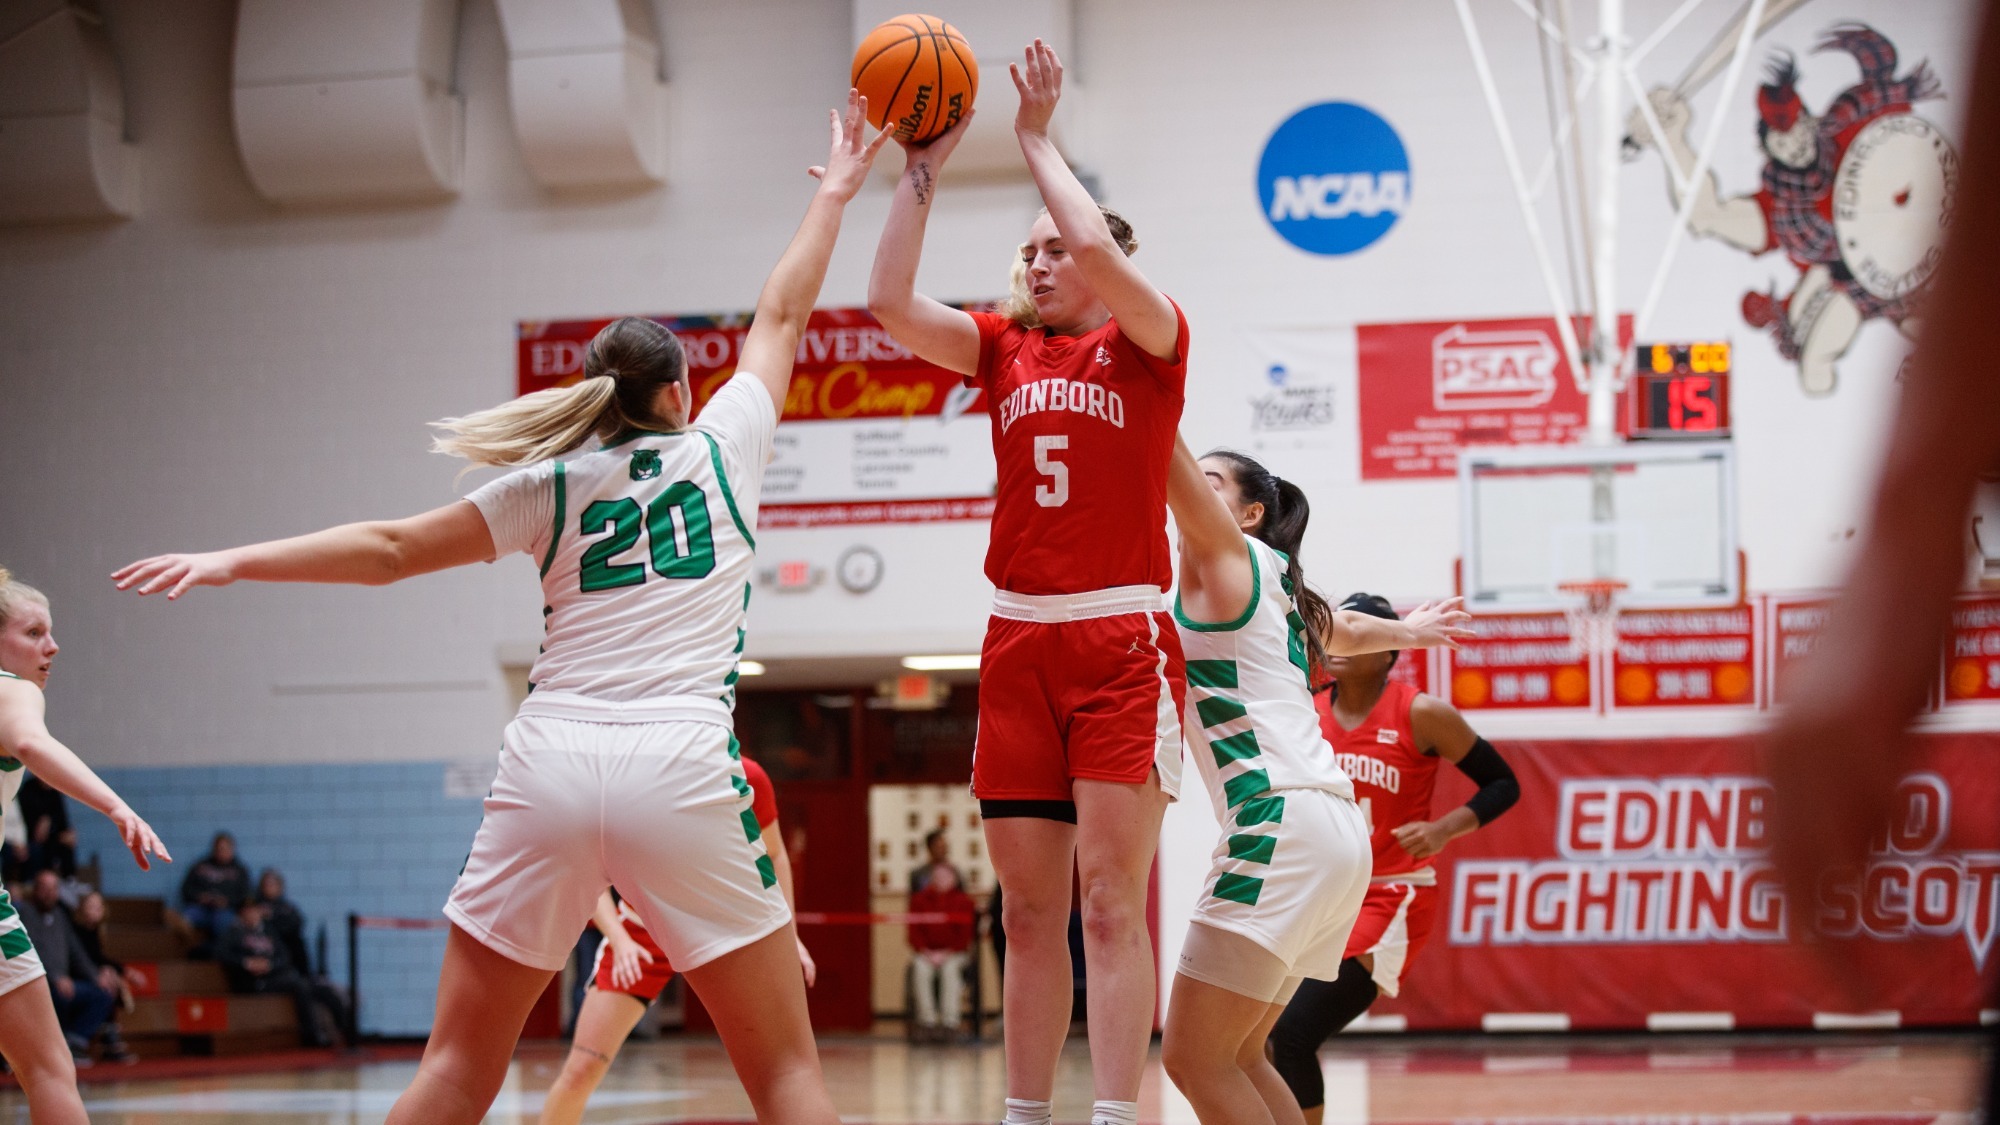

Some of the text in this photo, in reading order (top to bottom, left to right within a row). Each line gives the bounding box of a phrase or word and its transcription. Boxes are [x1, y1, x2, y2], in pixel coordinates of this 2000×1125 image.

[1269, 171, 1410, 222] NCAA
[818, 361, 935, 424] Camp
[1442, 355, 1547, 383] PSAC
[999, 378, 1124, 437] EDINBORO
[1667, 376, 1717, 432] 15
[1034, 435, 1069, 508] 5
[580, 479, 716, 593] 20
[1335, 752, 1400, 795] BORO
[1448, 860, 1789, 943] FIGHTING
